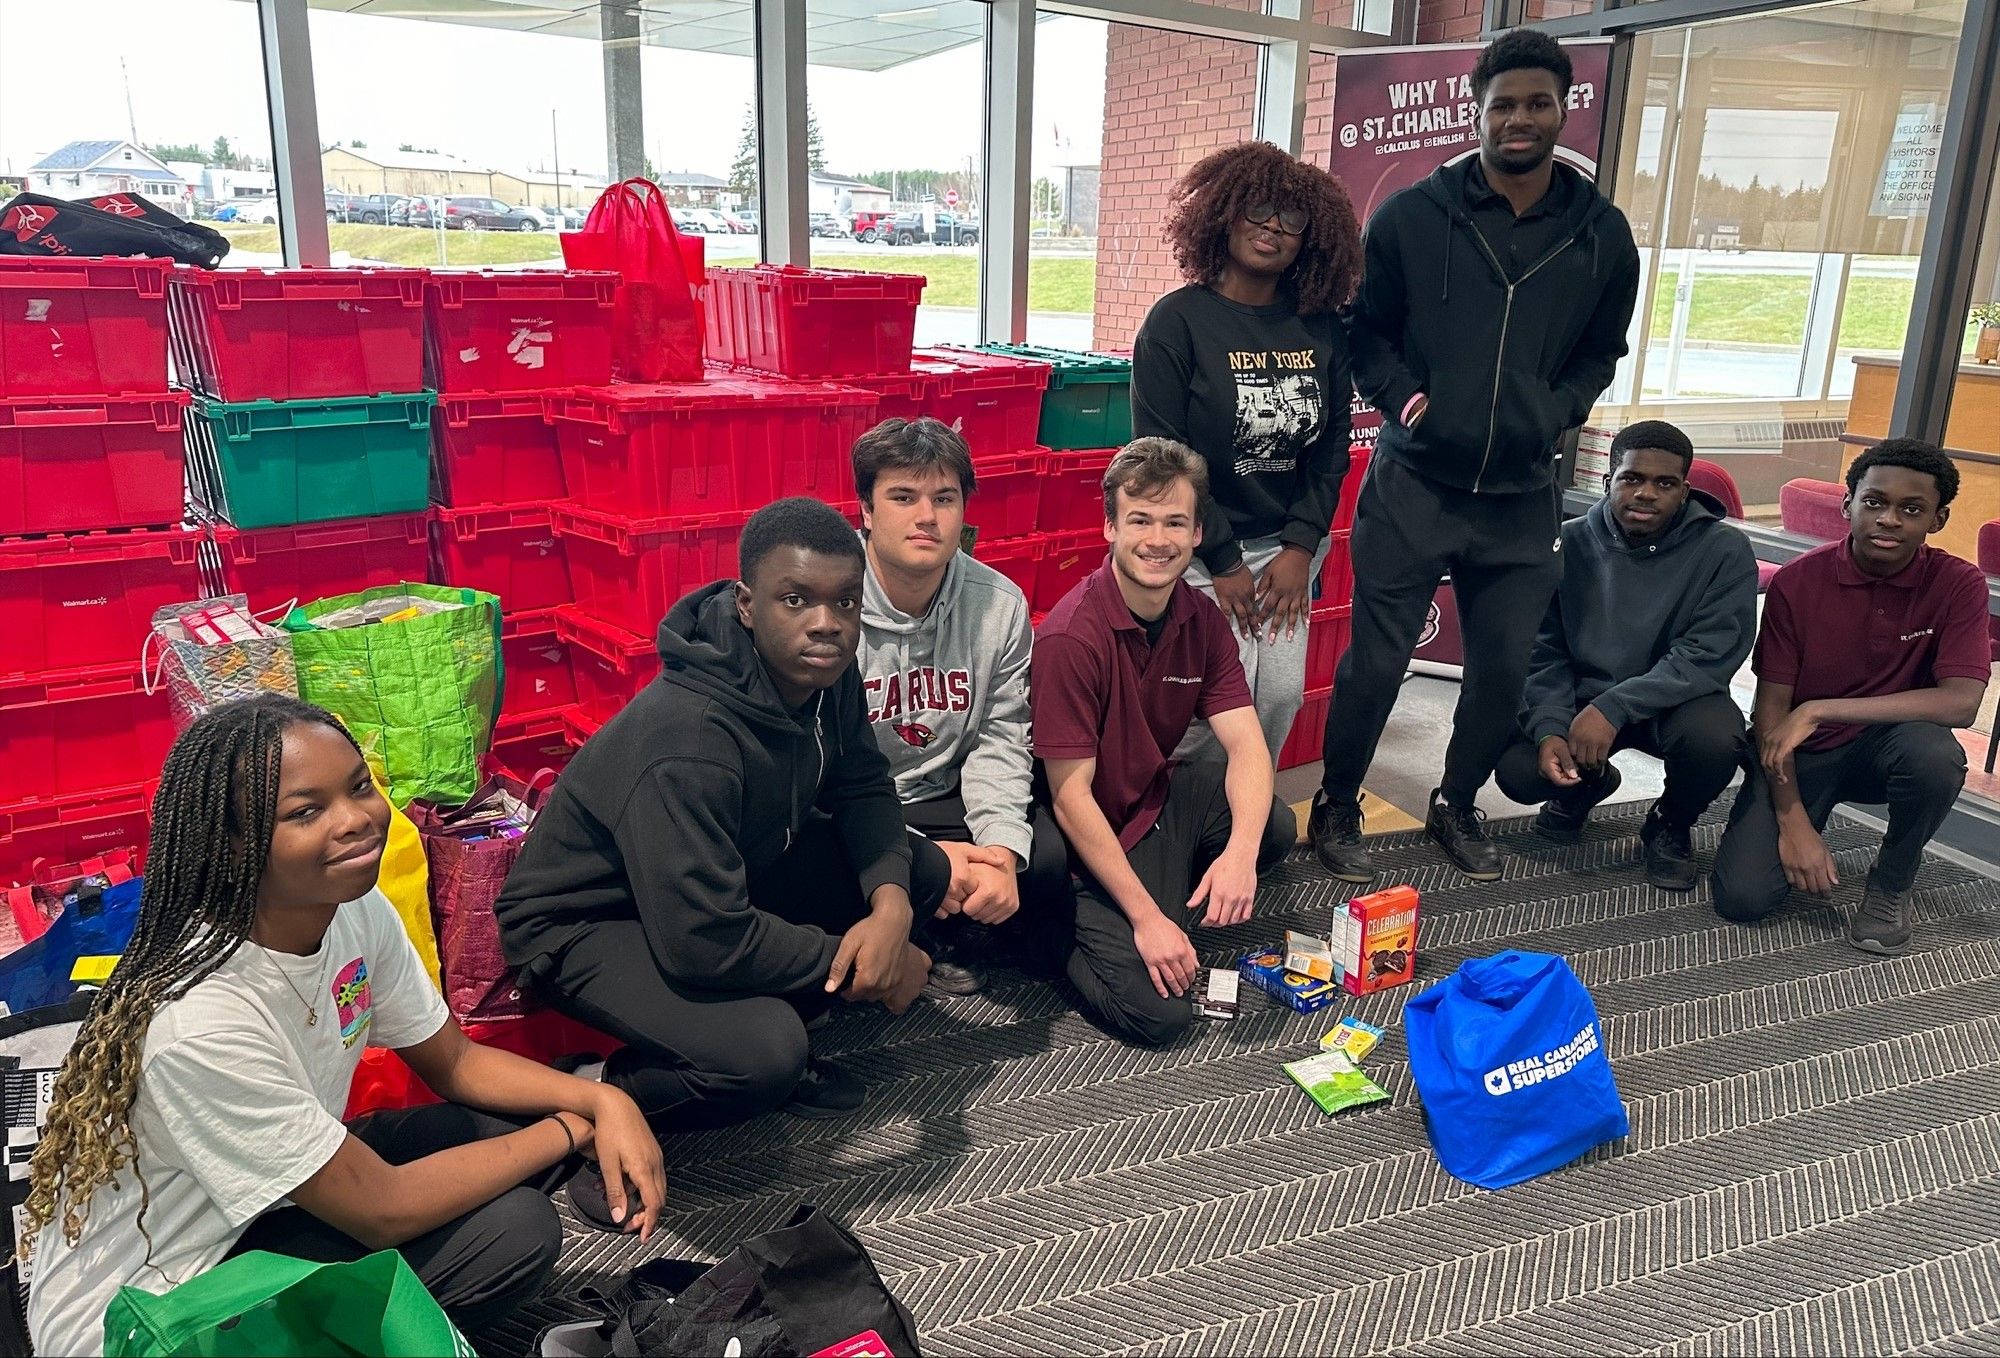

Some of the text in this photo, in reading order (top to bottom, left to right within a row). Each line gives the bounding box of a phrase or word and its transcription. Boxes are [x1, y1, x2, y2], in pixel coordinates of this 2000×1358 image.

[1388, 80, 1437, 109] WHY
[1896, 125, 1943, 134] WELCOME
[1339, 124, 1358, 148] @
[1383, 139, 1421, 154] CALCULUS
[1433, 132, 1465, 147] ENGLISH
[1906, 137, 1922, 145] ALL
[1893, 147, 1936, 157] VISITORS
[1897, 159, 1923, 168] MUST
[1884, 170, 1919, 179] REPORT
[1882, 181, 1935, 190] THE OFFICE
[1879, 193, 1896, 201] AND
[1228, 349, 1316, 369] NEW YORK
[62, 598, 98, 607] Walmart.ca
[81, 831, 116, 840] Walmart.ca
[1507, 1024, 1594, 1075] REAL CANADIAN
[1512, 1034, 1599, 1090] SUPERSTORE
